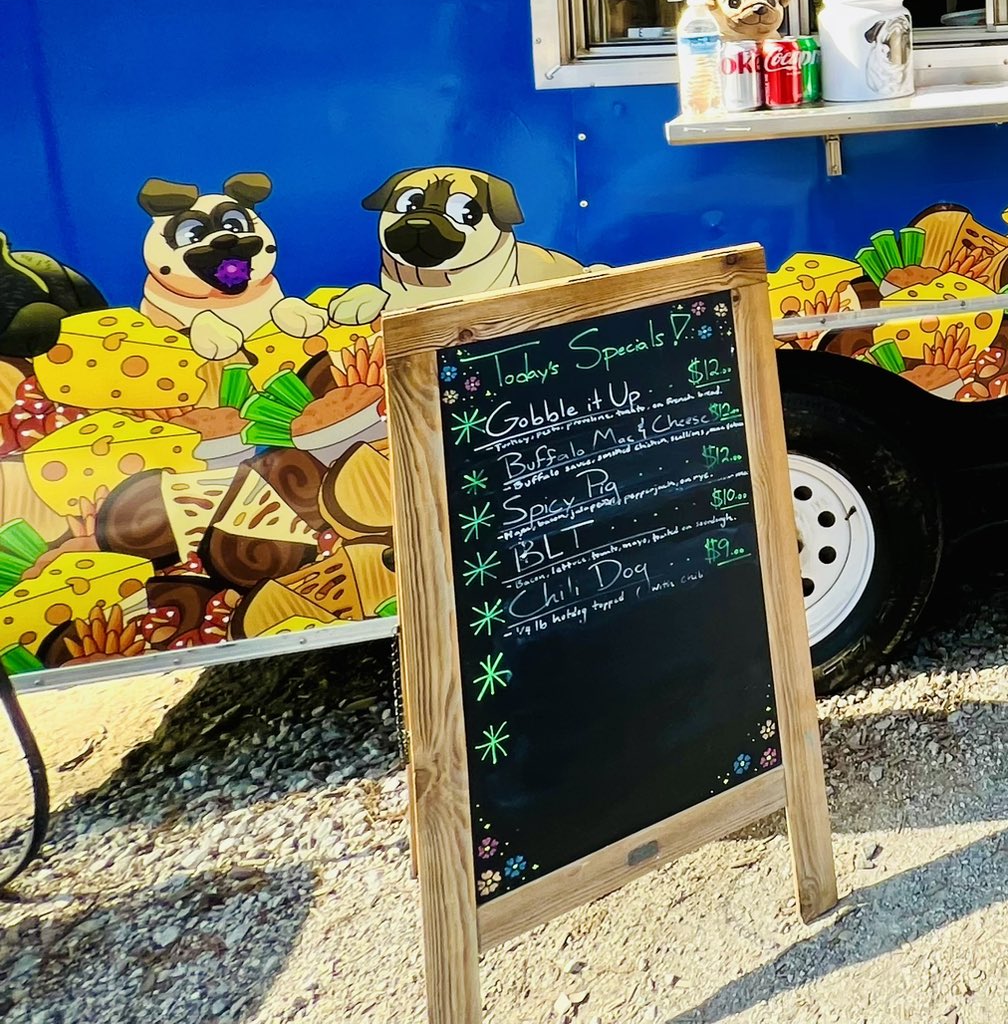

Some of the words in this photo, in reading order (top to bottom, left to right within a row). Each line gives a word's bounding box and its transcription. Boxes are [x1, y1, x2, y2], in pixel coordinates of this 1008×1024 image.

[460, 340, 559, 387] Today's
[486, 398, 579, 437] Gobble
[587, 387, 602, 412] it
[609, 380, 641, 410] Up
[497, 440, 585, 479] Buffalo
[592, 427, 635, 451] Mac
[651, 414, 710, 433] Cheese
[502, 495, 576, 529] Spicy
[576, 468, 621, 505] Pig
[508, 519, 595, 573] BLT
[508, 576, 580, 618] Chili
[587, 559, 651, 592] Dog
[535, 620, 547, 631] lb
